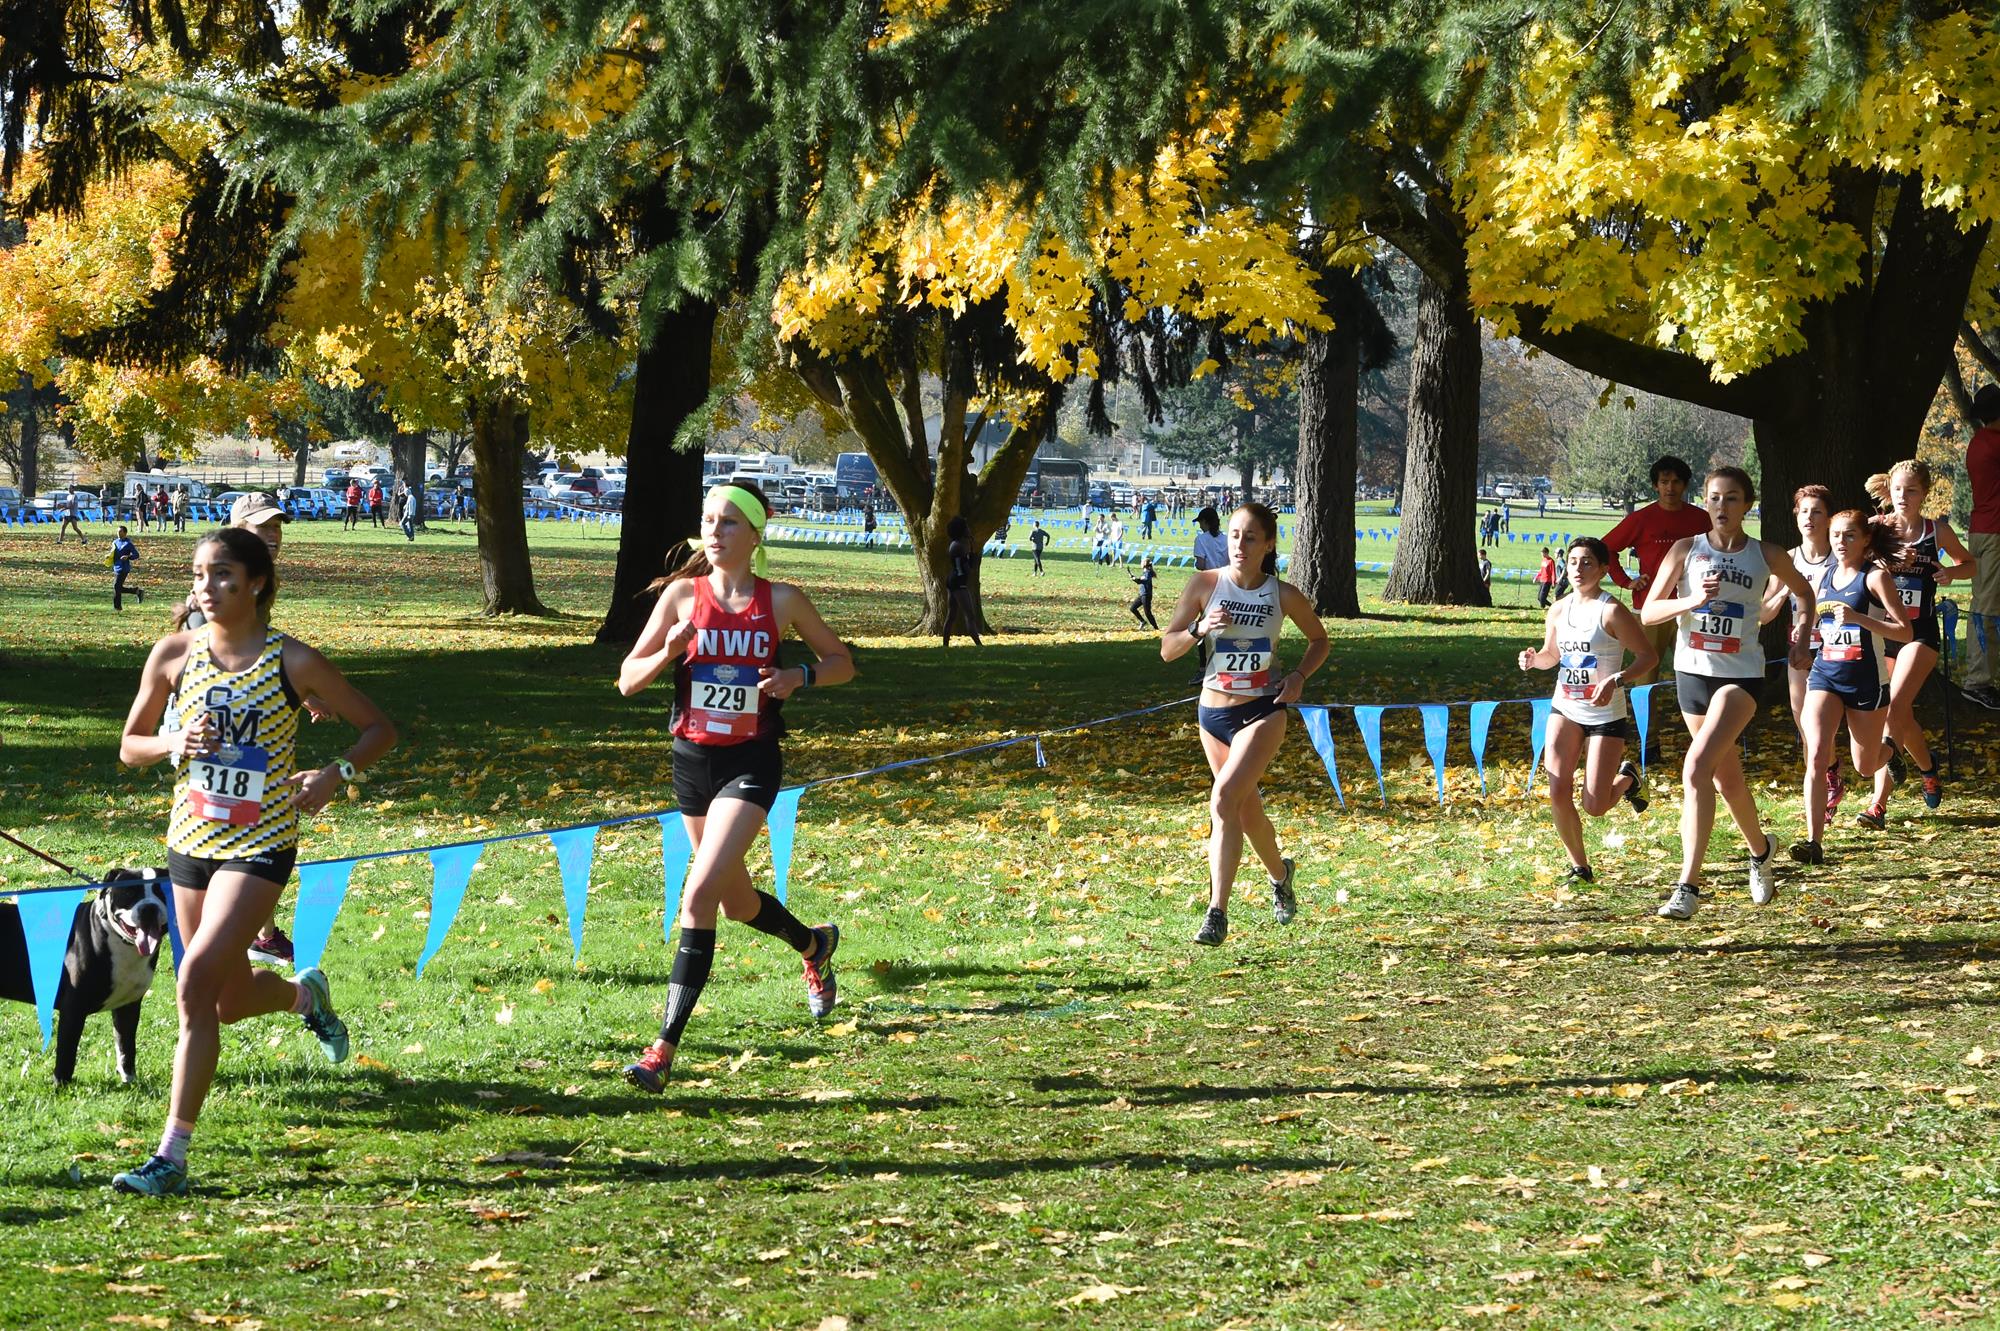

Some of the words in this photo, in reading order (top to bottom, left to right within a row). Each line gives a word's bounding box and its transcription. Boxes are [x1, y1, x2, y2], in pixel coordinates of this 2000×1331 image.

[1219, 599, 1275, 617] SHAWNEE
[1231, 612, 1267, 628] TATE
[1699, 615, 1733, 636] 130
[696, 628, 770, 658] NWC
[1828, 630, 1852, 645] 20
[1225, 653, 1261, 671] 278
[1565, 668, 1590, 685] 269
[703, 684, 747, 711] 229
[201, 764, 250, 798] 318
